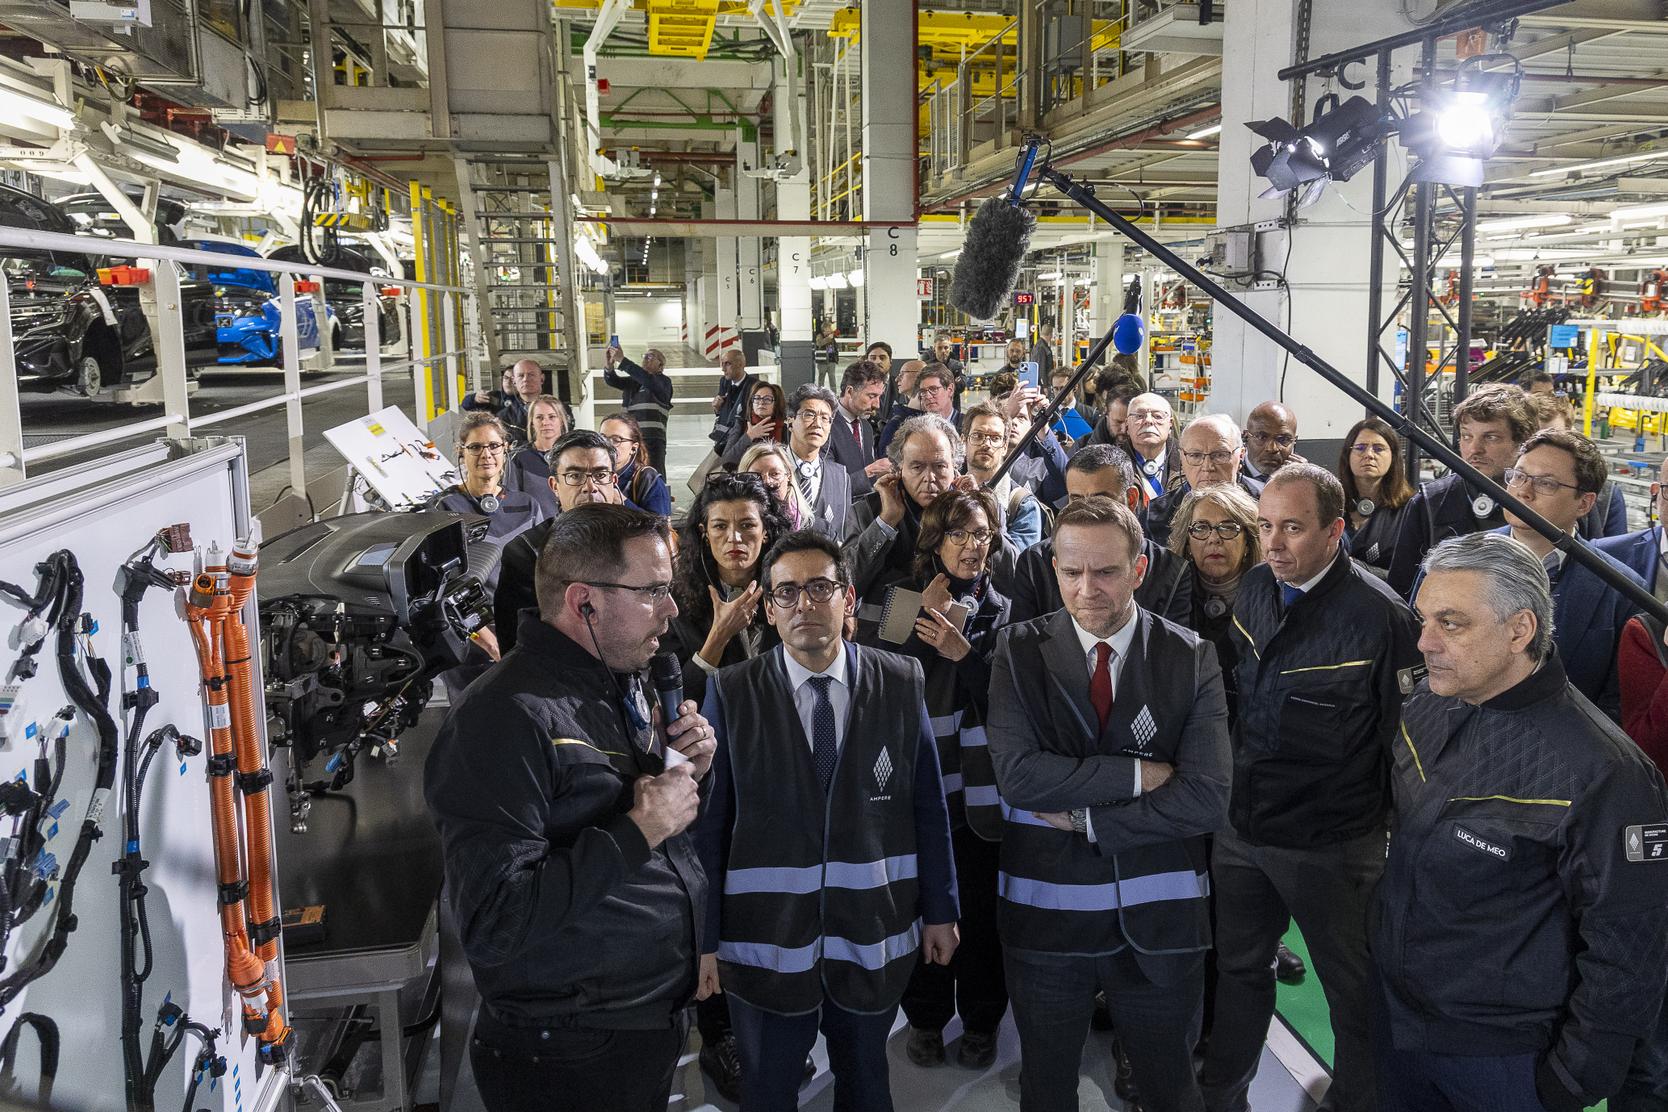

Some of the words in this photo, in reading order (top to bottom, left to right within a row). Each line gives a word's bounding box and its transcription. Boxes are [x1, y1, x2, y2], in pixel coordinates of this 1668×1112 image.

[888, 226, 900, 239] C
[792, 252, 800, 261] C
[890, 243, 898, 257] 8
[793, 265, 799, 274] 7
[1017, 295, 1032, 303] 957
[1457, 829, 1475, 845] LUCA
[1475, 839, 1487, 850] DE
[1486, 844, 1506, 857] MEO
[1651, 843, 1663, 857] 5
